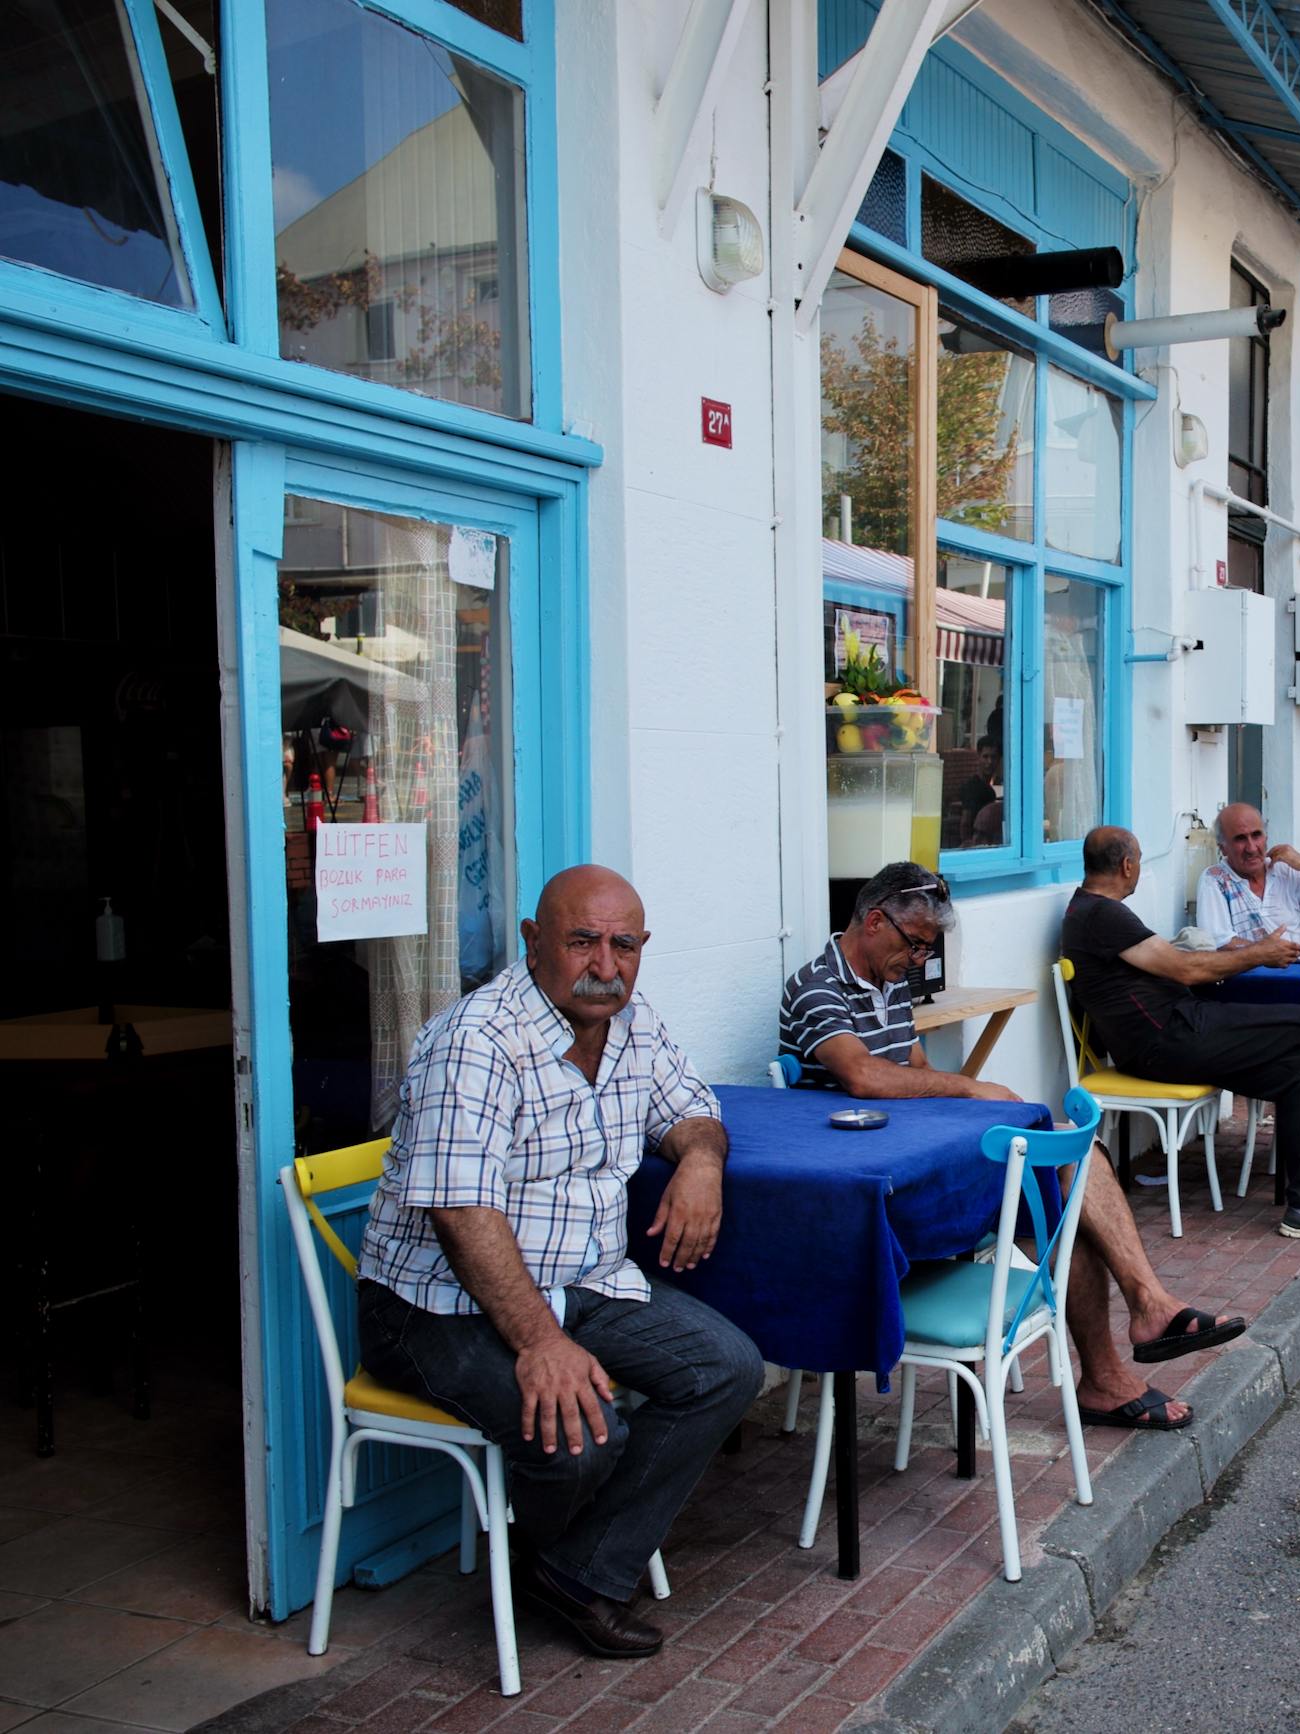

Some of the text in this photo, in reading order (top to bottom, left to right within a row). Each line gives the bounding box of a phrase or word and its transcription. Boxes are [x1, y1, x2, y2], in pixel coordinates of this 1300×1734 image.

[324, 830, 408, 858] LÜTFEN
[320, 867, 407, 890] BOZUK PARA
